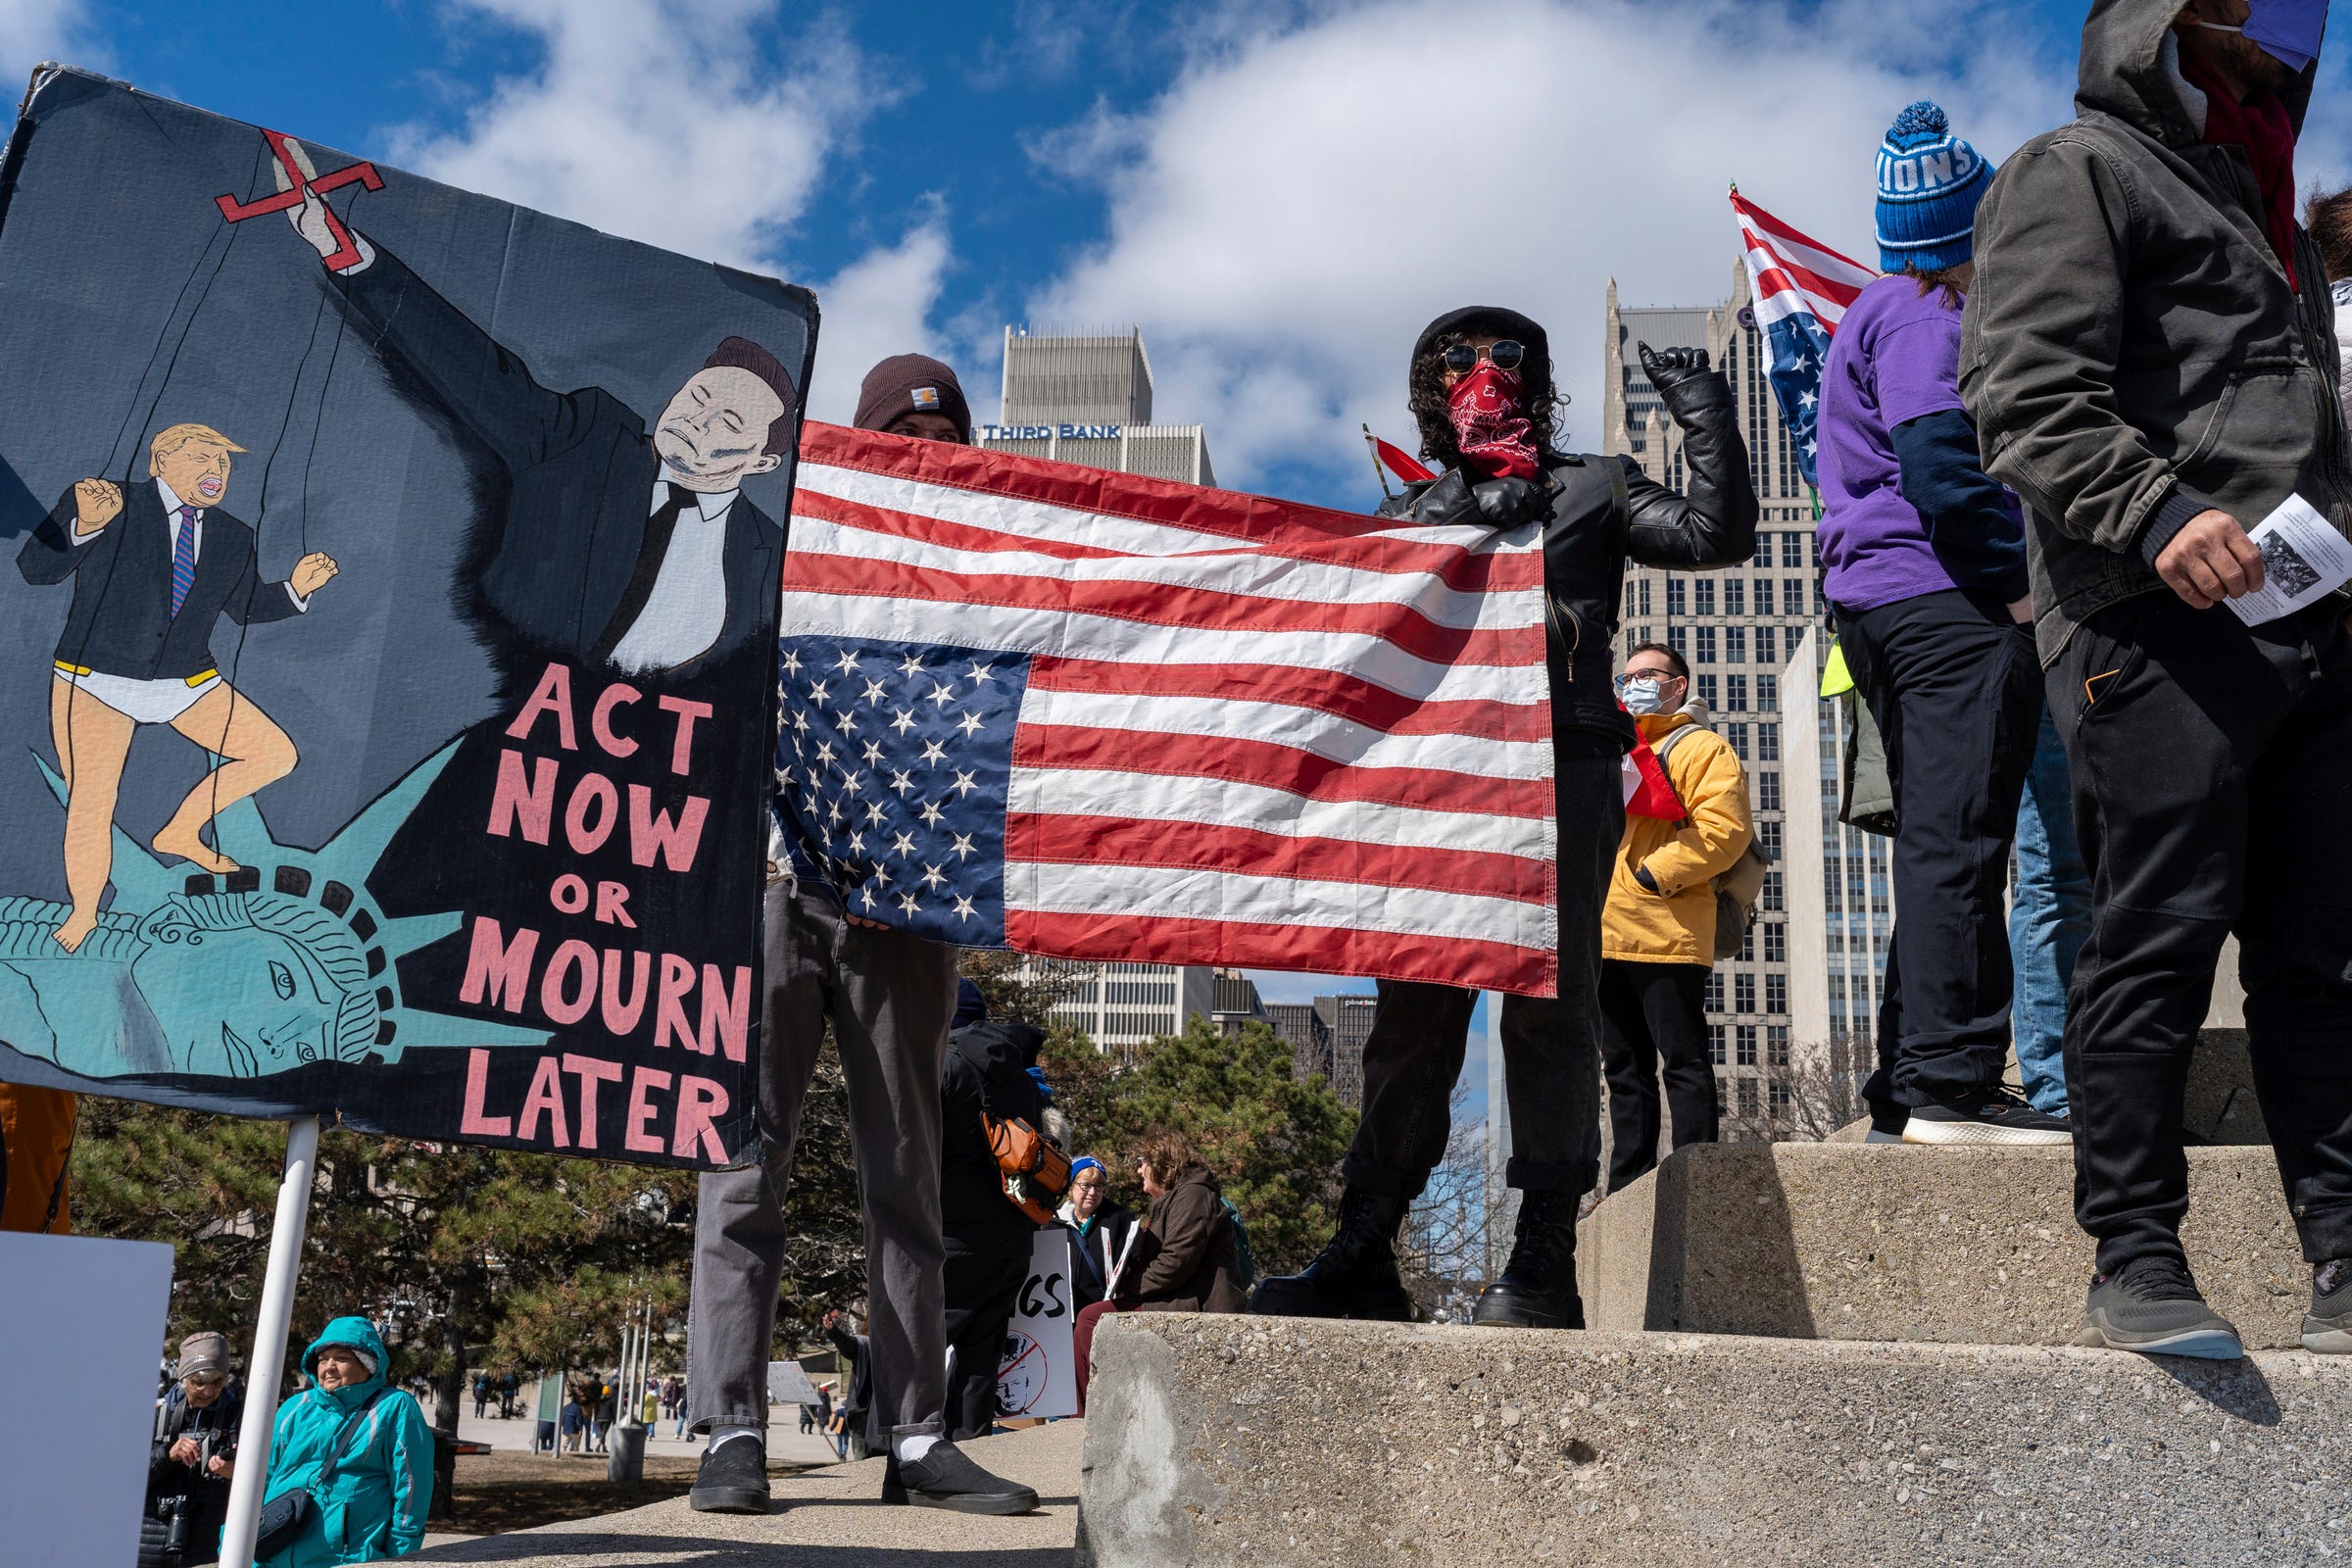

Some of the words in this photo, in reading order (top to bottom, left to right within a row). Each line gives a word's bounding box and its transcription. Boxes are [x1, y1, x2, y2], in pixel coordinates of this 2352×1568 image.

[983, 424, 1052, 440] THIRD
[1059, 423, 1121, 439] BANK
[506, 662, 712, 775] ACT
[487, 749, 710, 872] NOW
[550, 873, 637, 928] OR
[460, 916, 752, 1062] MOURN
[461, 1049, 730, 1164] LATER
[1008, 1273, 1065, 1318] GS
